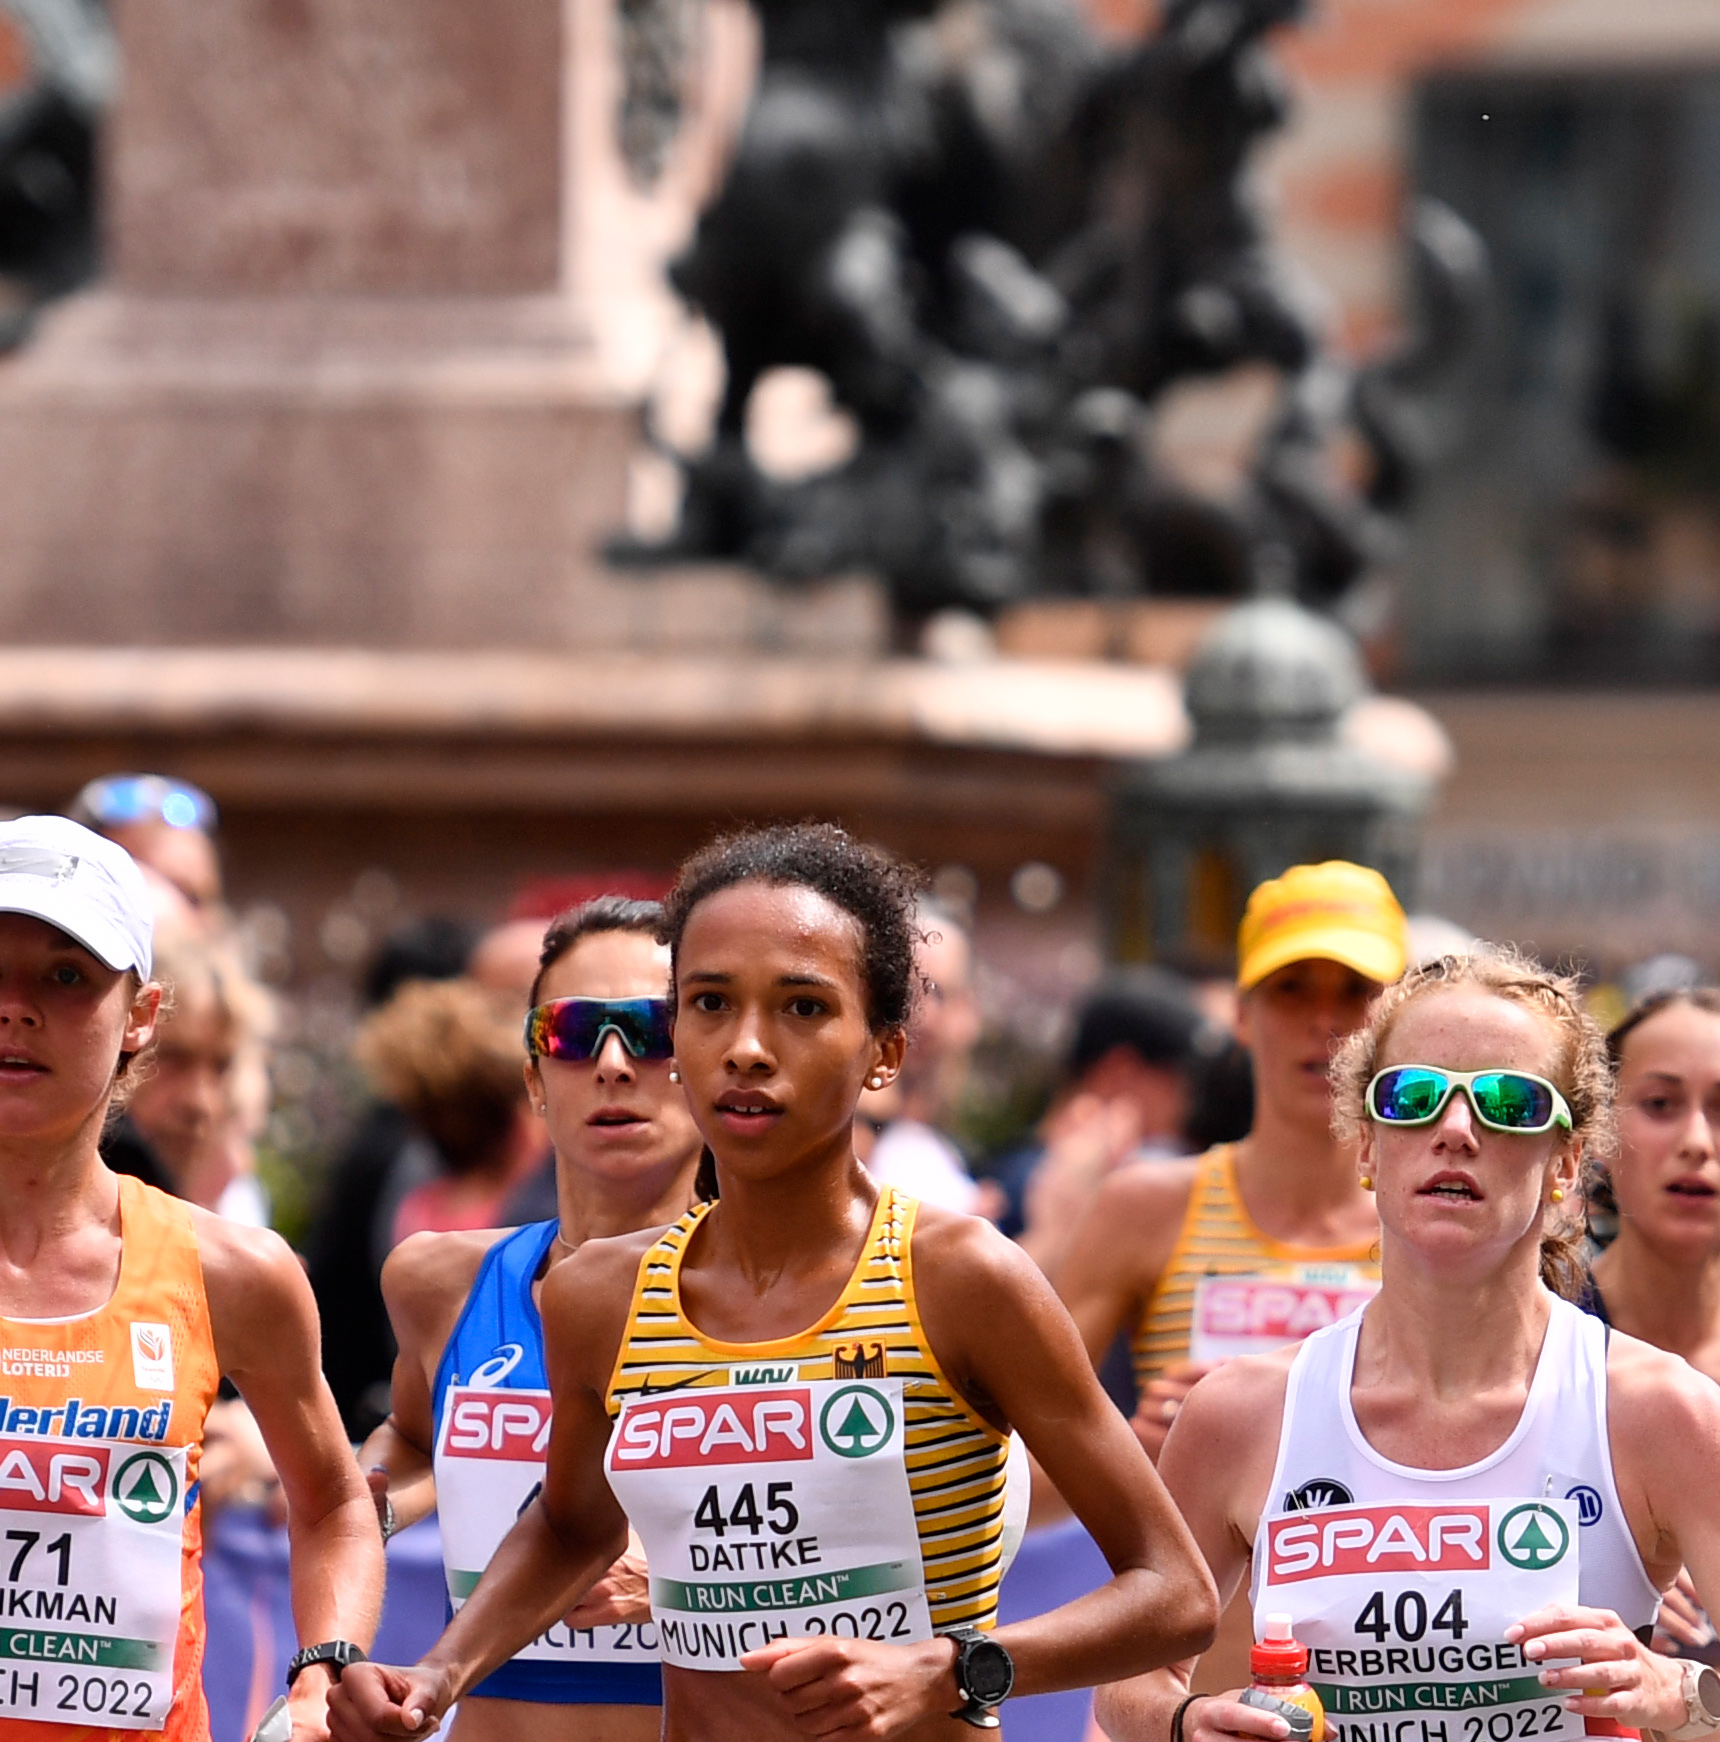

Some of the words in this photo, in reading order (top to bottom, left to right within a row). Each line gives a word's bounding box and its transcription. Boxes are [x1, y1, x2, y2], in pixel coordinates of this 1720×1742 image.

[2, 1348, 104, 1364] NEDERLANDSE
[2, 1362, 70, 1378] LOTERIJ
[617, 1399, 807, 1461] SPAR
[694, 1481, 800, 1538] 445
[689, 1536, 822, 1573] DATTKE
[1273, 1513, 1483, 1576] SPAR
[686, 1586, 692, 1608] I
[698, 1584, 747, 1609] RUN
[1354, 1588, 1468, 1643] 404
[661, 1617, 787, 1659] MUNICH
[57, 1674, 153, 1719] 2022
[1336, 1688, 1341, 1709] I
[1349, 1689, 1406, 1711] RUN
